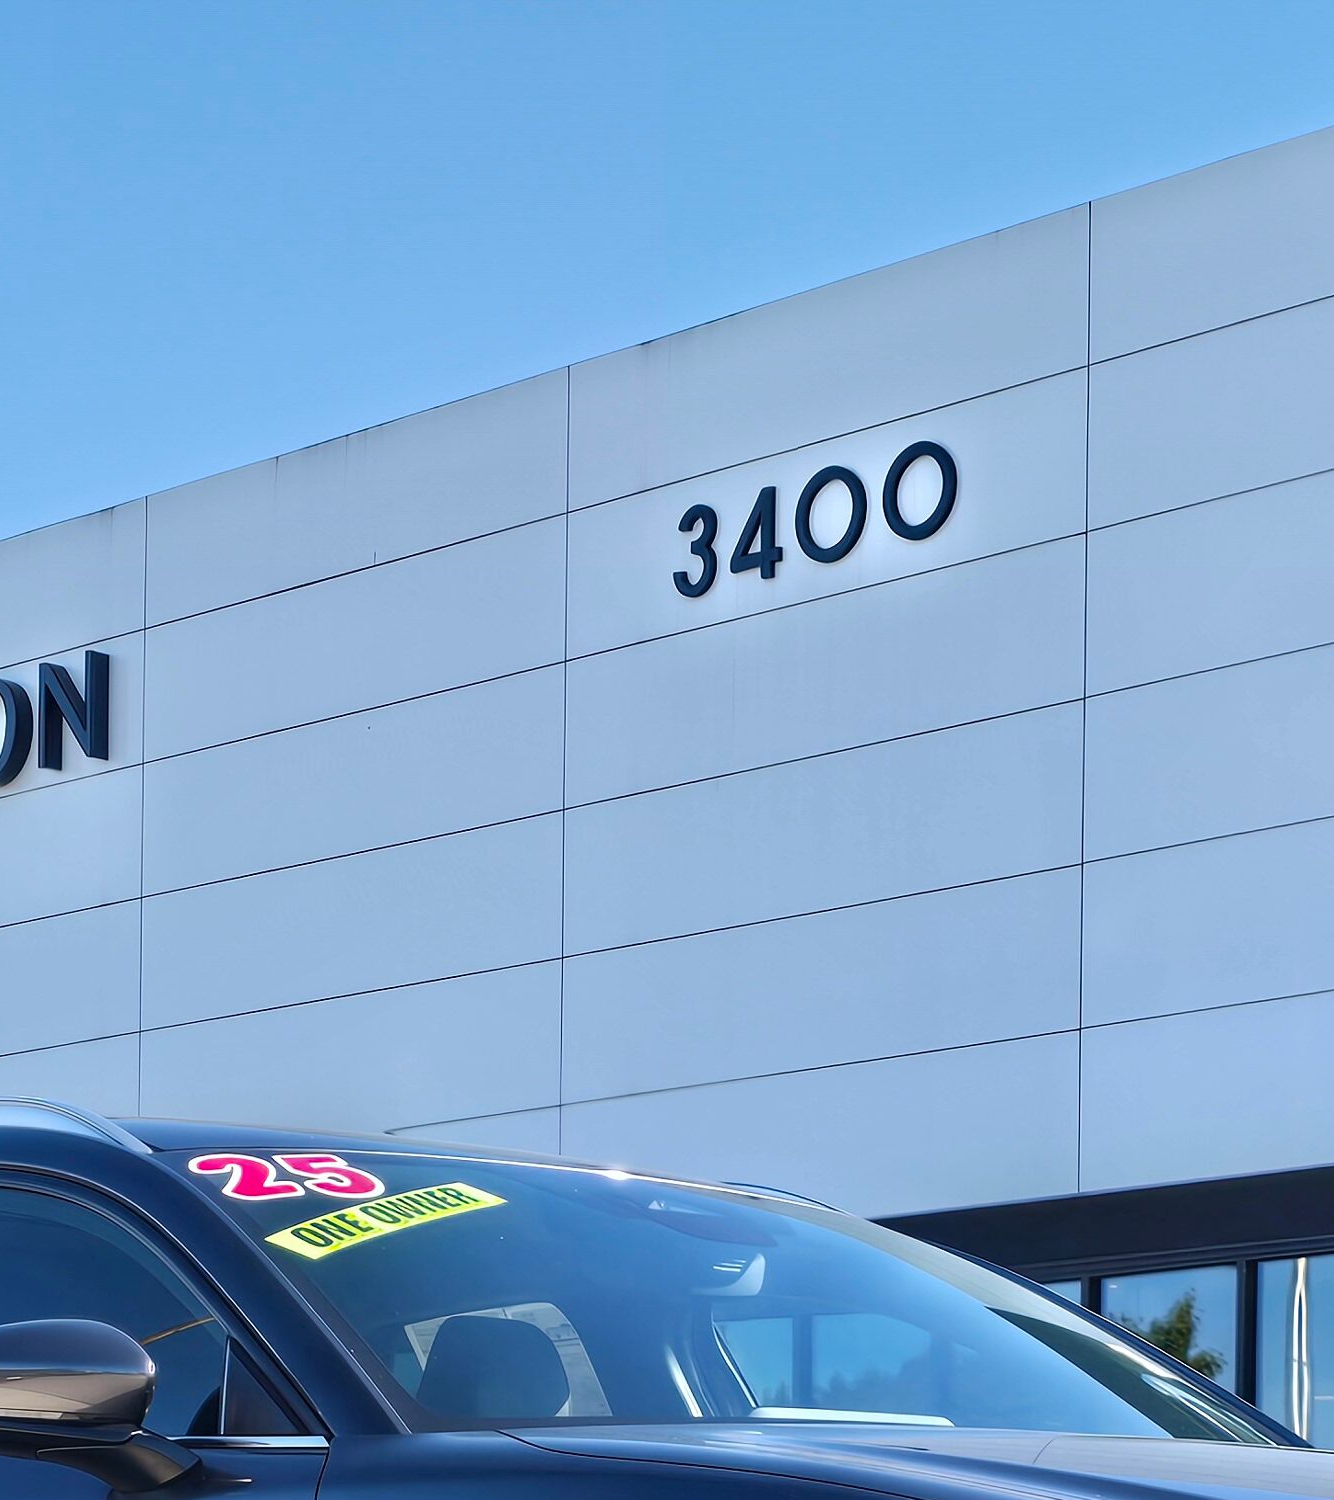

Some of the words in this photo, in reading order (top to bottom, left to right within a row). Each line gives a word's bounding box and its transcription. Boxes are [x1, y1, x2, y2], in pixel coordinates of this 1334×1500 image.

[672, 440, 958, 598] 3400
[188, 1153, 386, 1201] 25
[290, 1212, 369, 1248] ONE
[368, 1186, 481, 1225] OWNER
